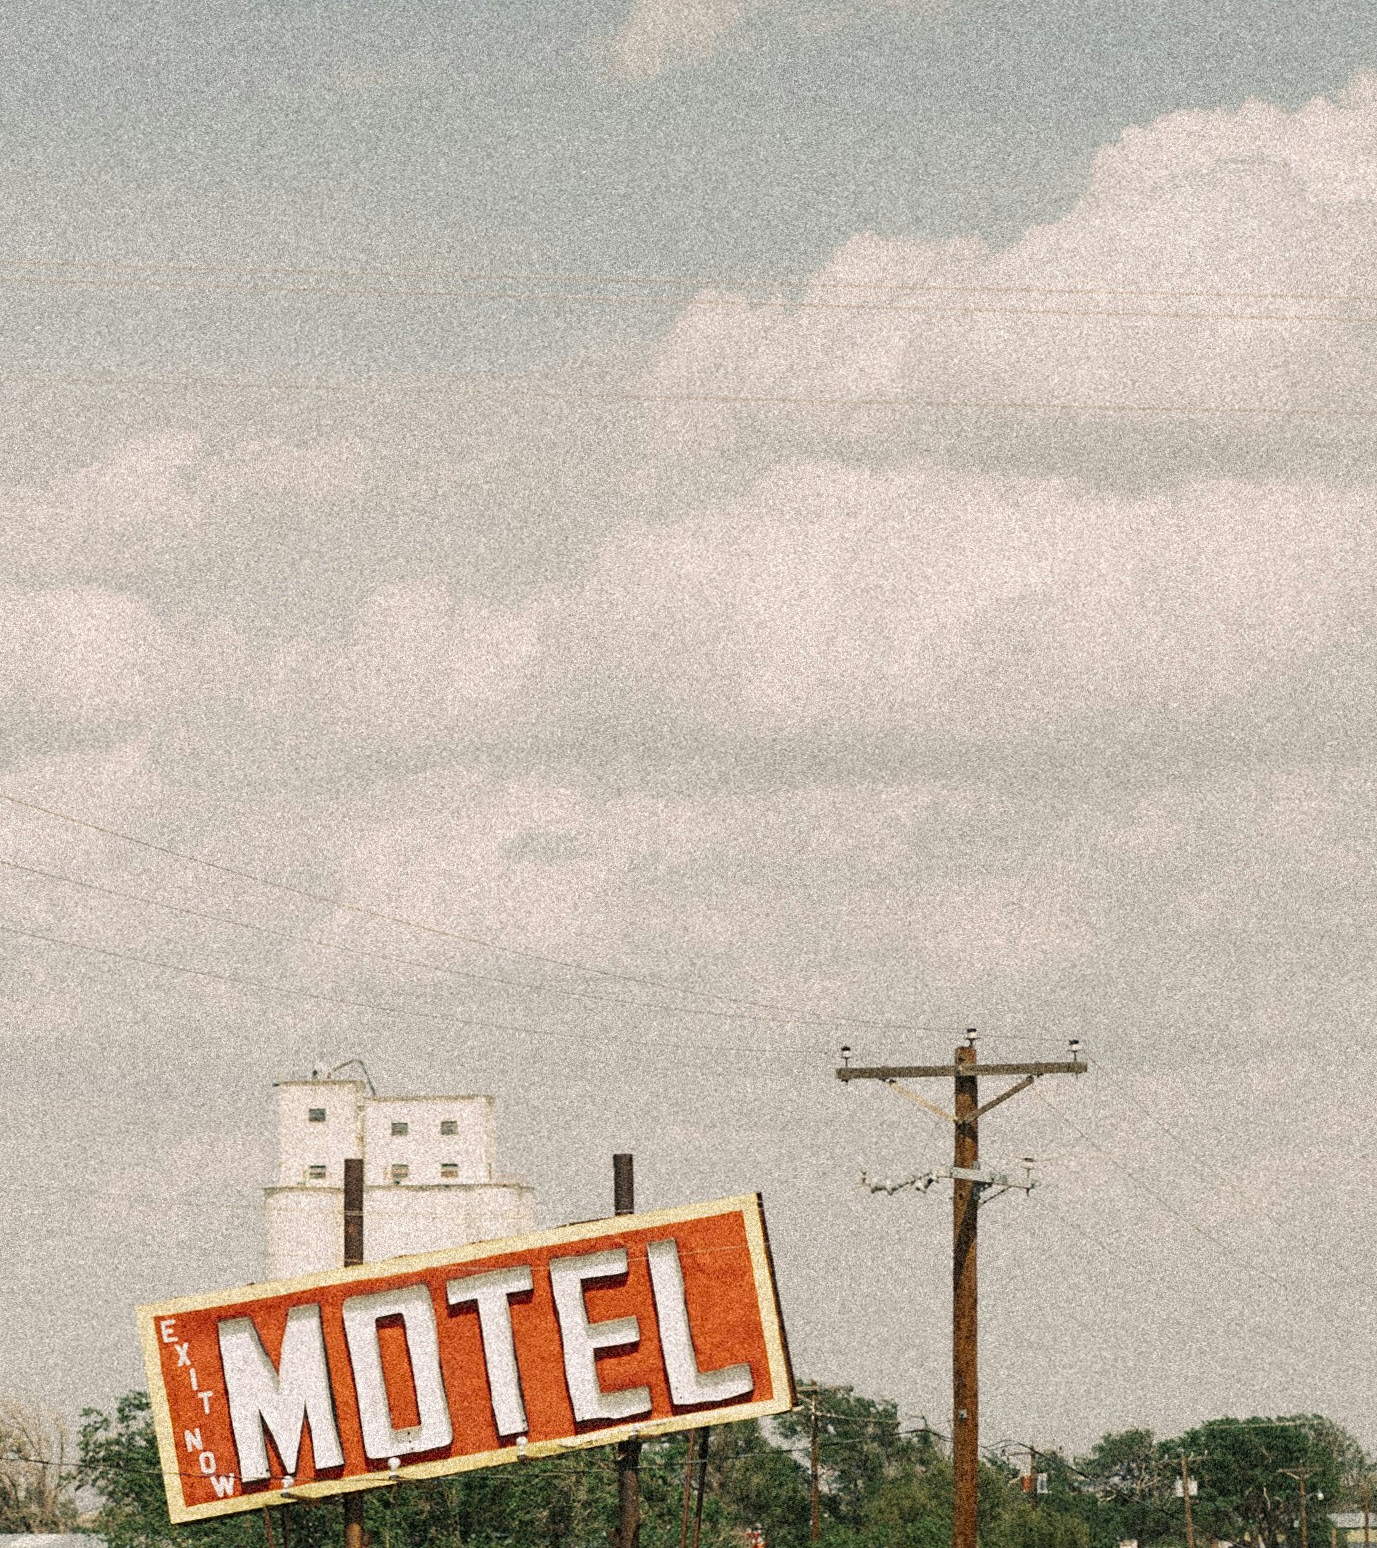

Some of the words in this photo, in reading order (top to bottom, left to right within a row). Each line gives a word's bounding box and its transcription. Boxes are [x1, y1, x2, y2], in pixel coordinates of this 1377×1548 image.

[160, 1319, 214, 1415] EXIT
[218, 1238, 754, 1482] MOTEL
[184, 1428, 235, 1498] NOW
